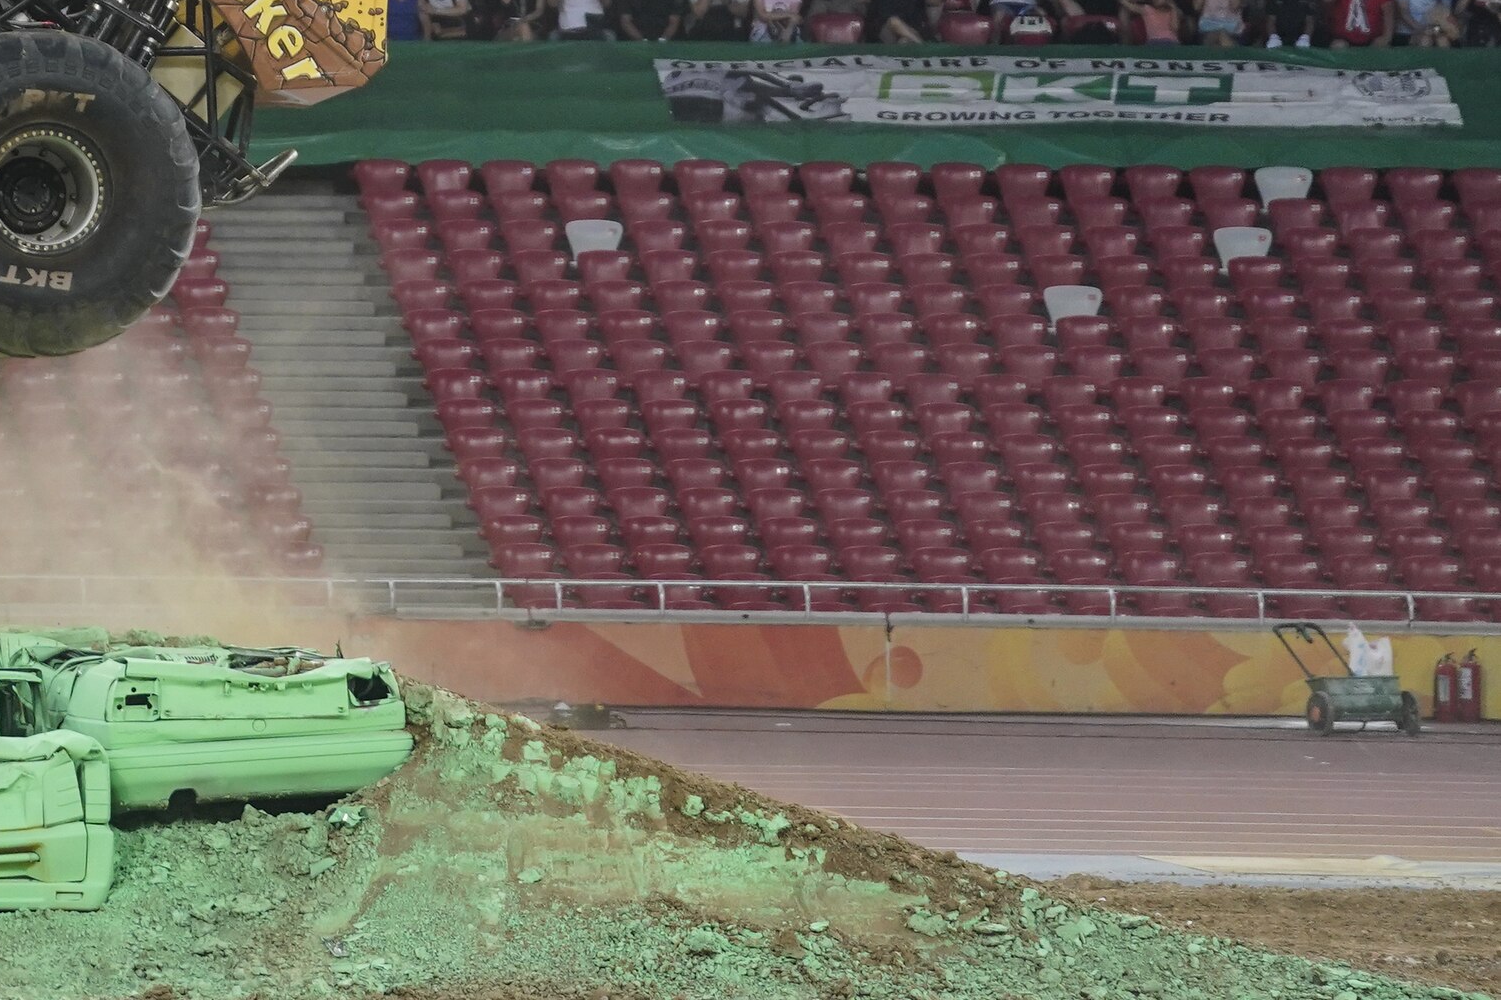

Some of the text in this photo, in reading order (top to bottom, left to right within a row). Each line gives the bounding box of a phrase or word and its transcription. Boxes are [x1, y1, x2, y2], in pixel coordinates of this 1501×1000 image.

[671, 56, 874, 70] OFFICIAL
[893, 56, 989, 68] TIRE
[1014, 59, 1067, 70] OF
[892, 74, 1221, 104] BKT
[877, 110, 1231, 122] GROWING TOGETHER
[0, 264, 74, 291] BKT
